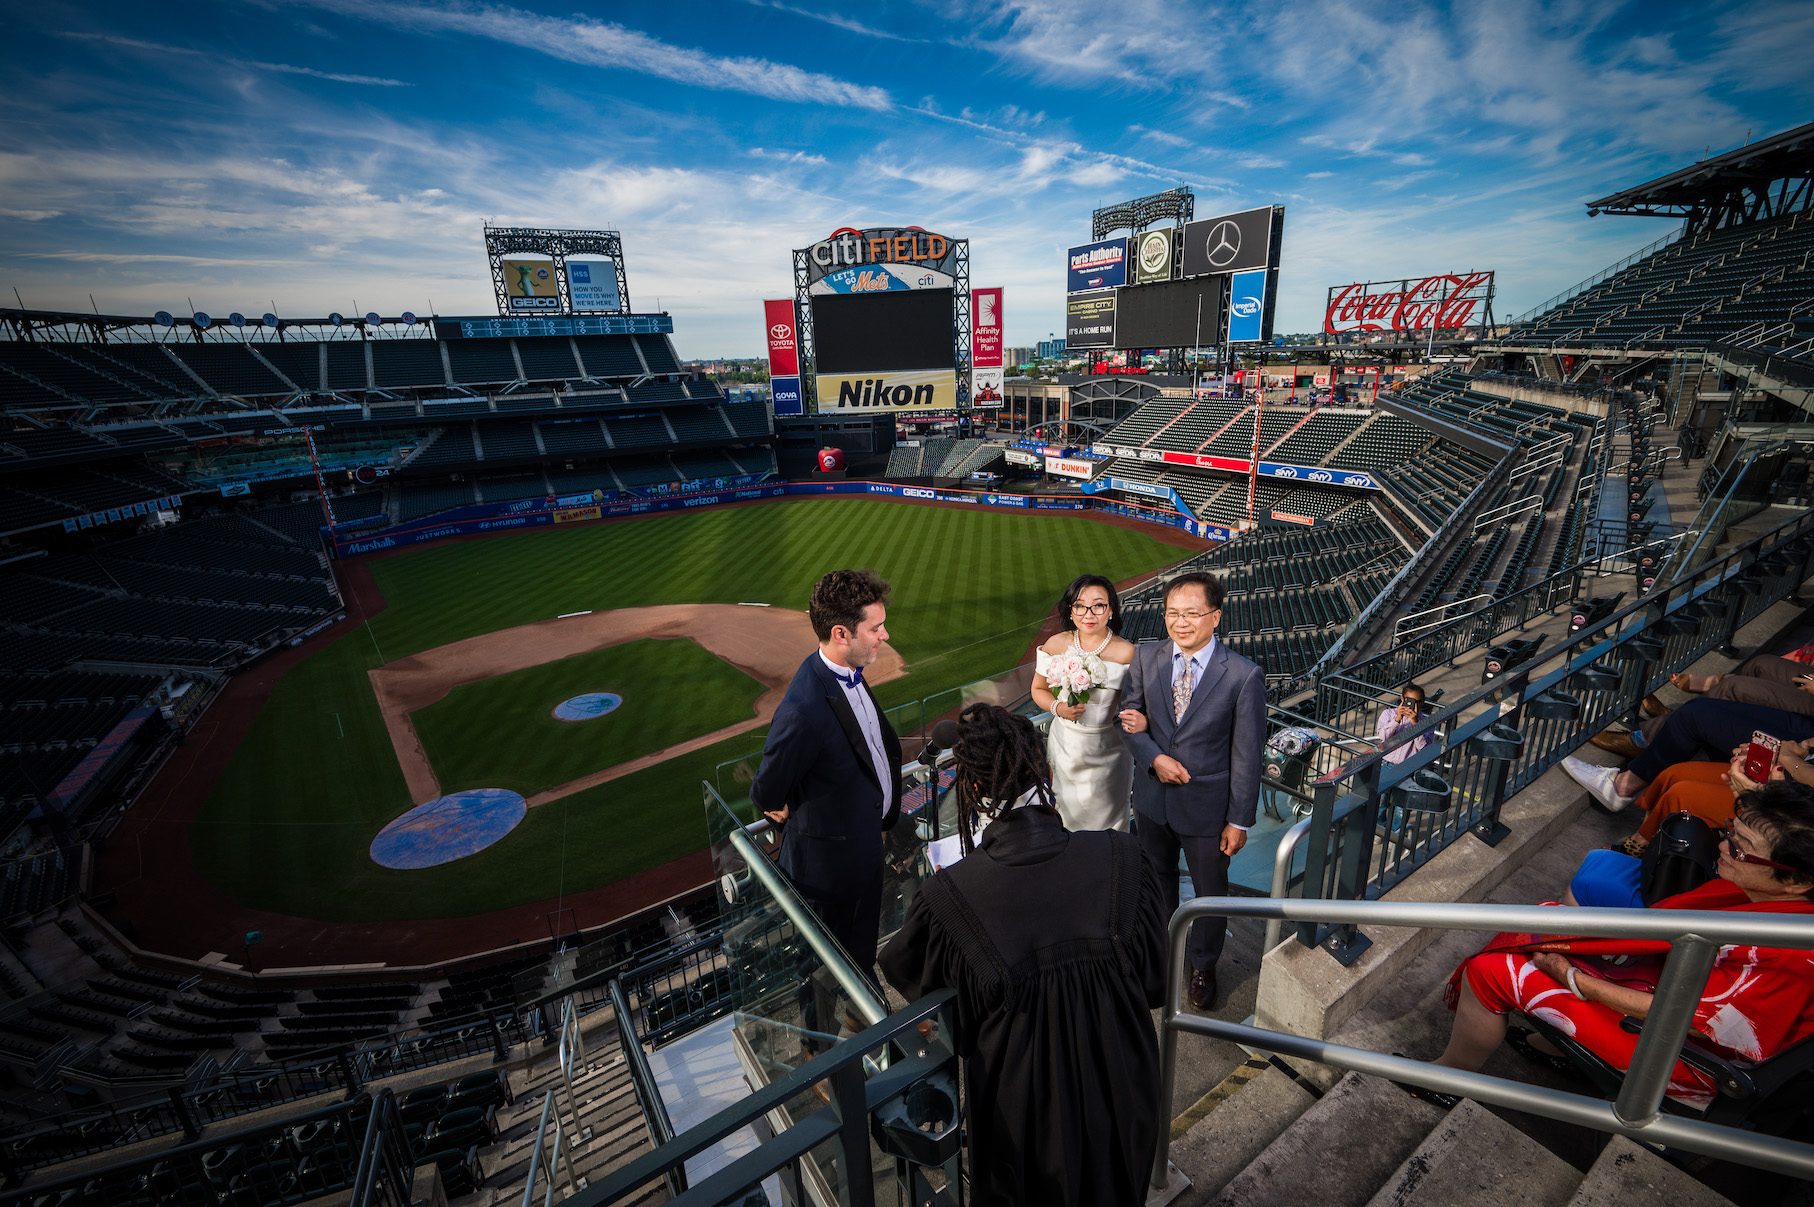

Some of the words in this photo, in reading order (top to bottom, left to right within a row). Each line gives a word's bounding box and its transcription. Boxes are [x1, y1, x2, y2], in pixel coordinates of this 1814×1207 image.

[812, 234, 862, 266] citi
[870, 235, 946, 262] FIELD
[1072, 253, 1089, 266] Parts
[1090, 246, 1123, 262] Authority
[833, 270, 855, 281] LET'S
[851, 270, 890, 292] Mets
[918, 274, 933, 286] citi
[512, 298, 557, 307] GEICO
[1070, 303, 1095, 311] EMPIRE
[838, 379, 934, 407] Nikon
[1062, 463, 1089, 474] DUNKIN'
[1275, 468, 1294, 477] SNY
[1308, 473, 1328, 482] SNY
[1344, 476, 1366, 486] SNY
[903, 488, 934, 499] GEICO
[1129, 484, 1156, 493] HONDA
[684, 496, 719, 507] verizon
[492, 518, 526, 528] HYUNDAI
[416, 528, 464, 541] JUSTWORKS.
[1208, 532, 1226, 541] Corona
[348, 537, 396, 555] Marshalls
